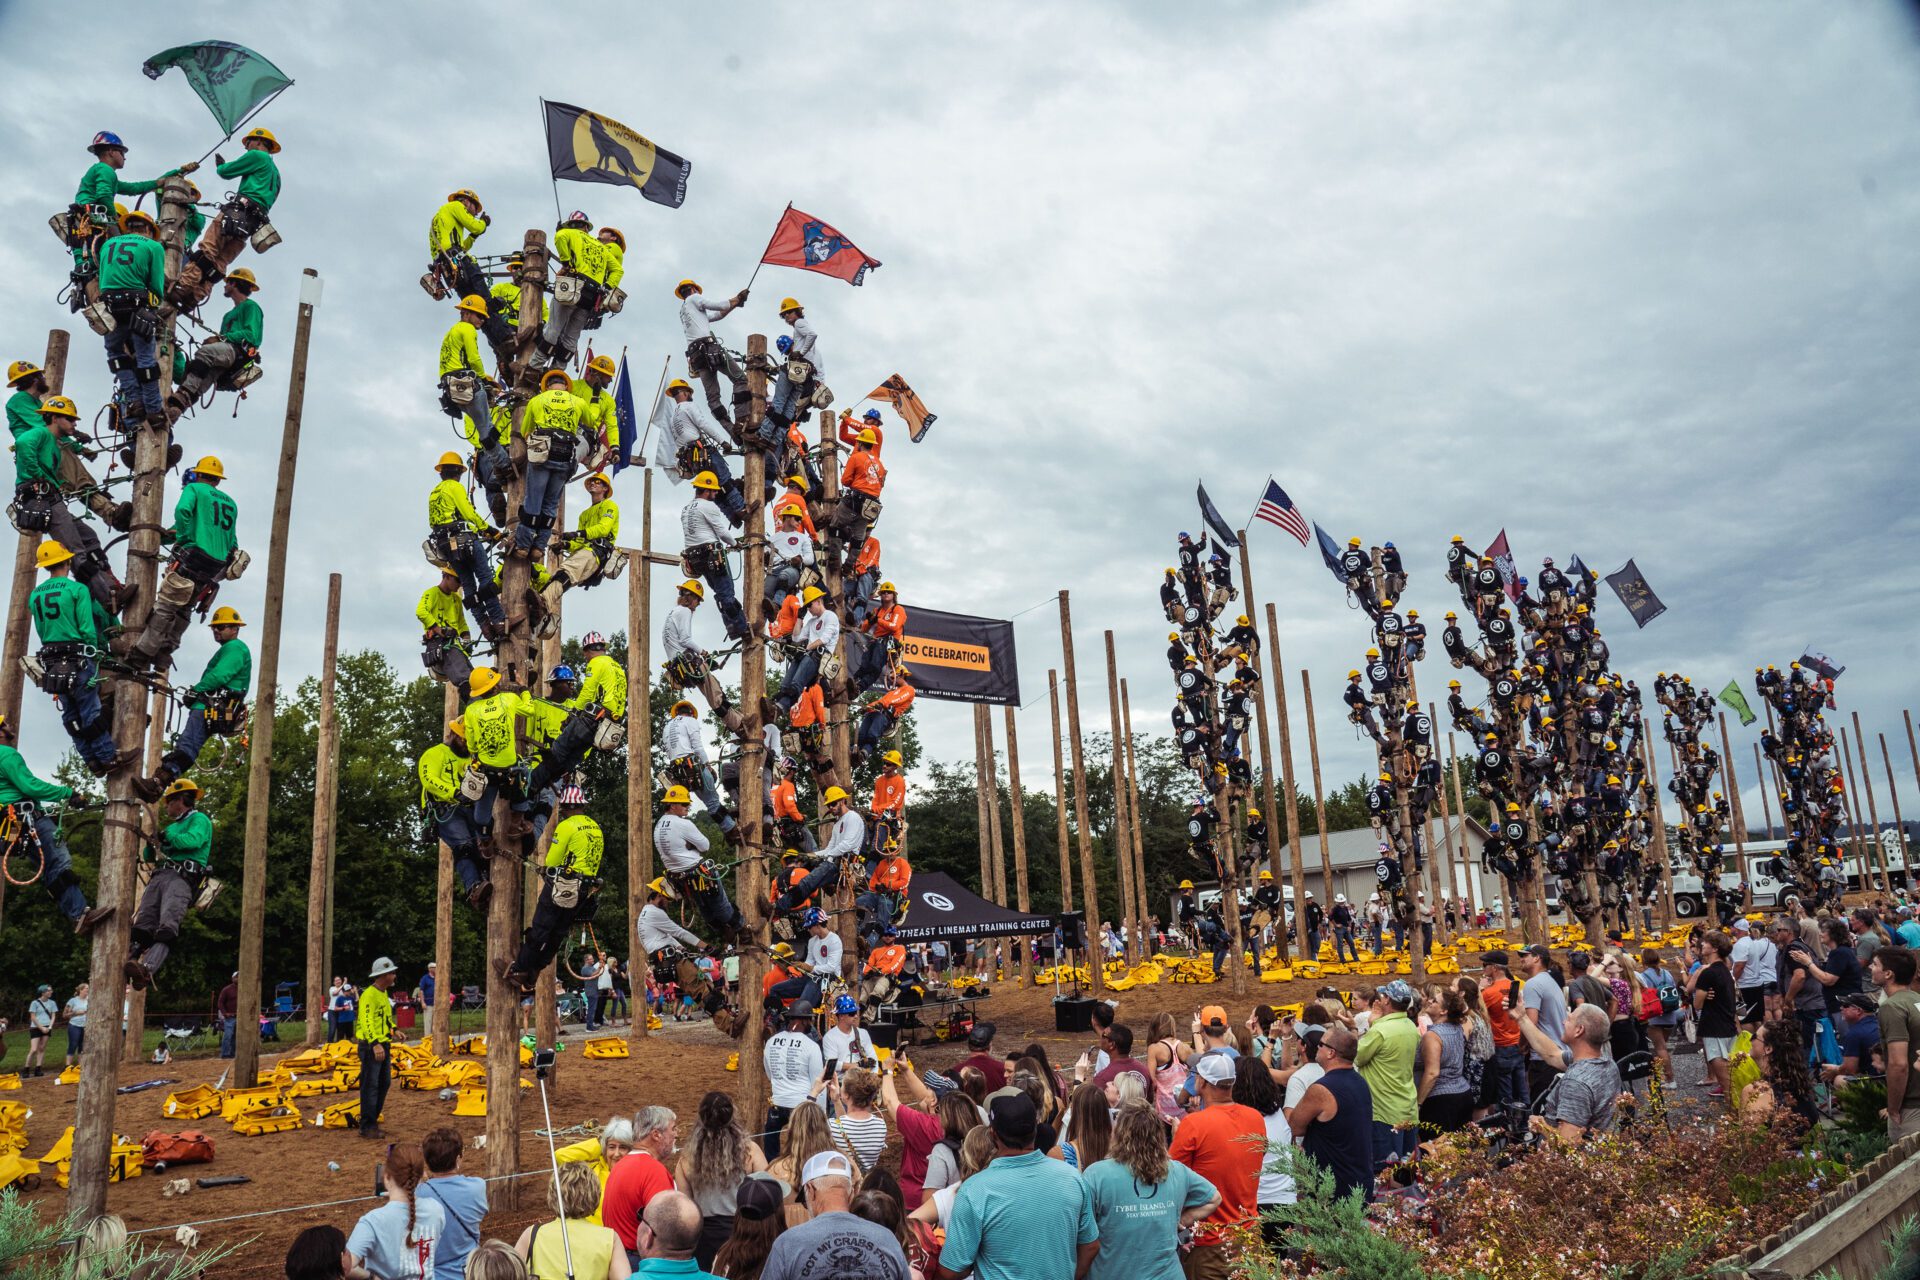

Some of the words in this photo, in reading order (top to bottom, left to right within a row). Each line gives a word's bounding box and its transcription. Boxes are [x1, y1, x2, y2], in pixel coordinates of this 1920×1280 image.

[675, 191, 683, 203] PUT
[679, 172, 688, 183] ALL
[107, 242, 138, 265] 15
[213, 501, 234, 531] 15
[34, 591, 61, 622] 15
[922, 645, 985, 664] CELEBRATION
[938, 924, 977, 935] LINEMAN
[979, 921, 1018, 932] TRAINING
[1020, 919, 1050, 930] CENTER
[772, 1037, 786, 1046] PC
[789, 1039, 802, 1047] 13
[1114, 1204, 1137, 1213] TYBEE
[1166, 1200, 1175, 1208] GA
[801, 1253, 818, 1277] GOT
[816, 1240, 832, 1255] MY
[833, 1237, 875, 1251] CRABS
[873, 1247, 891, 1279] FROM
